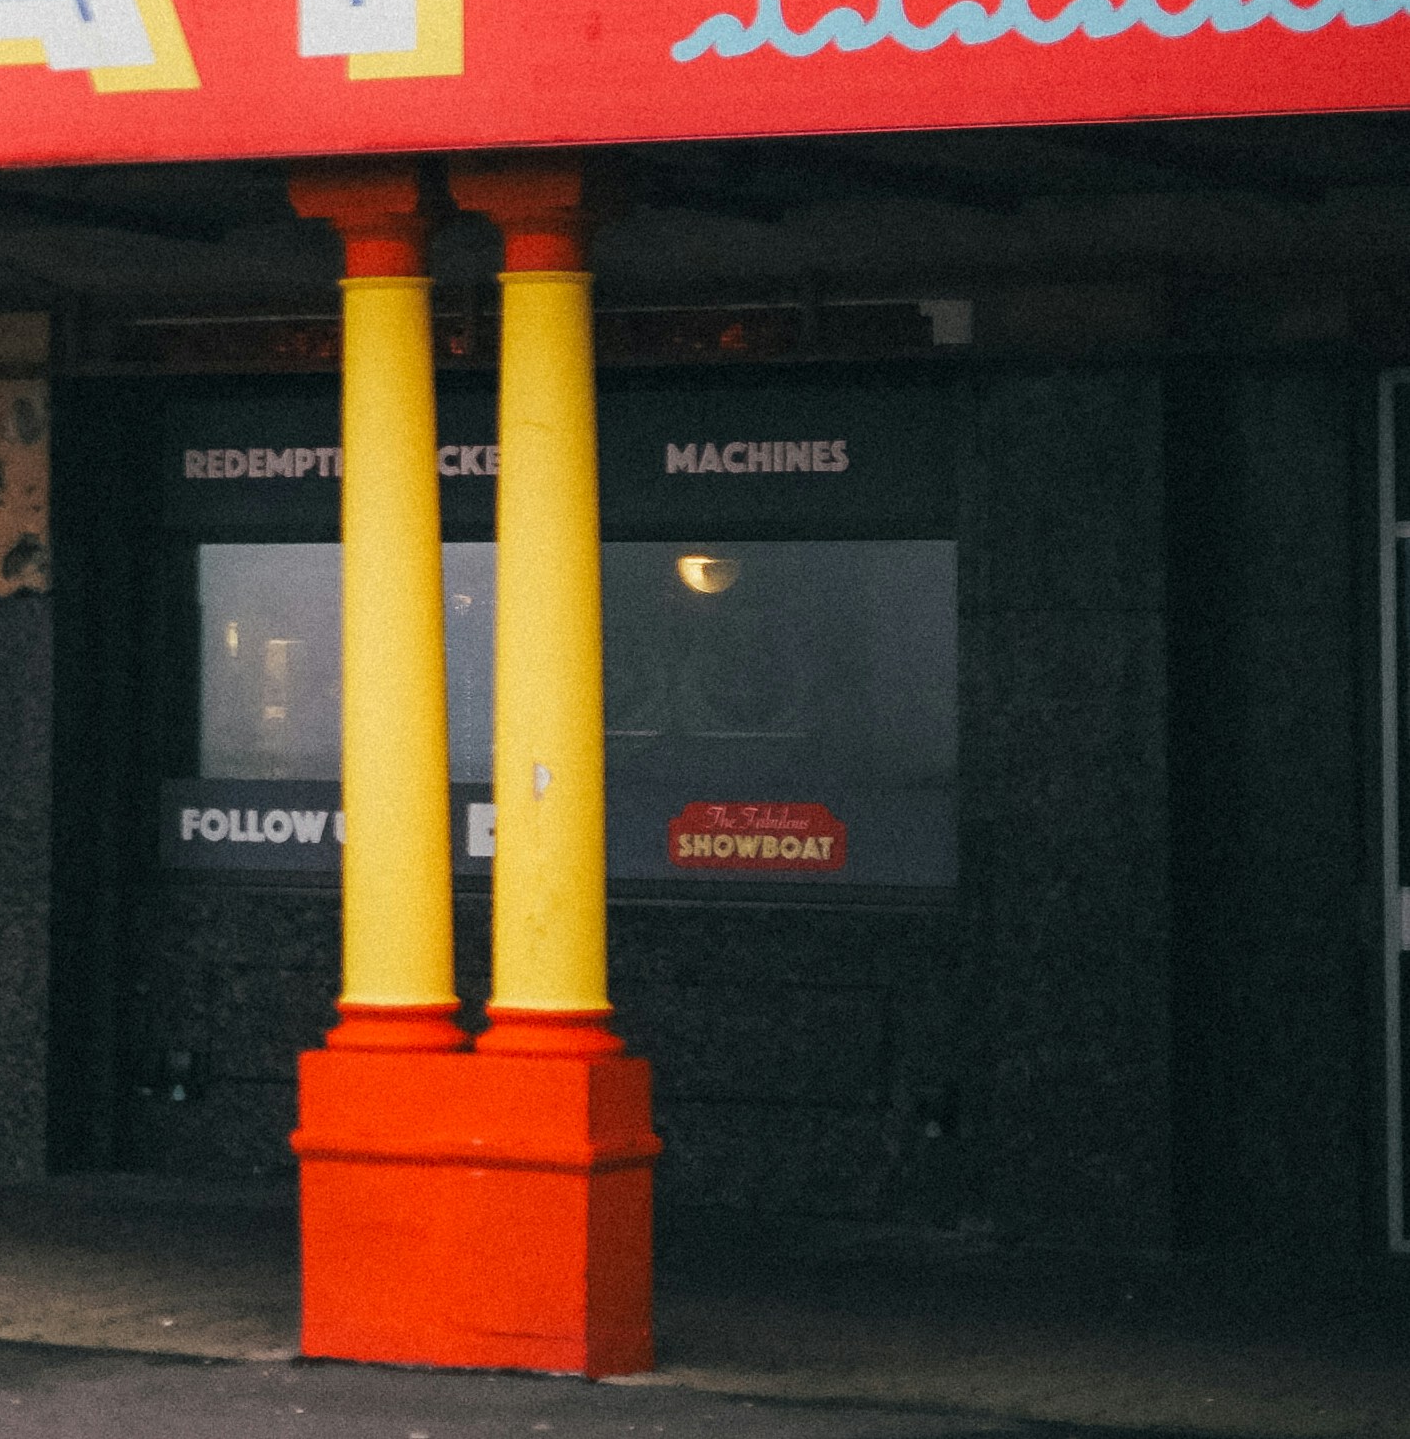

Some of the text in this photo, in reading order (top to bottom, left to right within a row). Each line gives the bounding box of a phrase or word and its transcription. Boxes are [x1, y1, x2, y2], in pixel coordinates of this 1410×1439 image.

[185, 447, 344, 479] REDEMPTI
[665, 440, 850, 474] MACHINES
[182, 808, 329, 844] FOLLOW
[678, 833, 835, 860] SHOWBOAT
